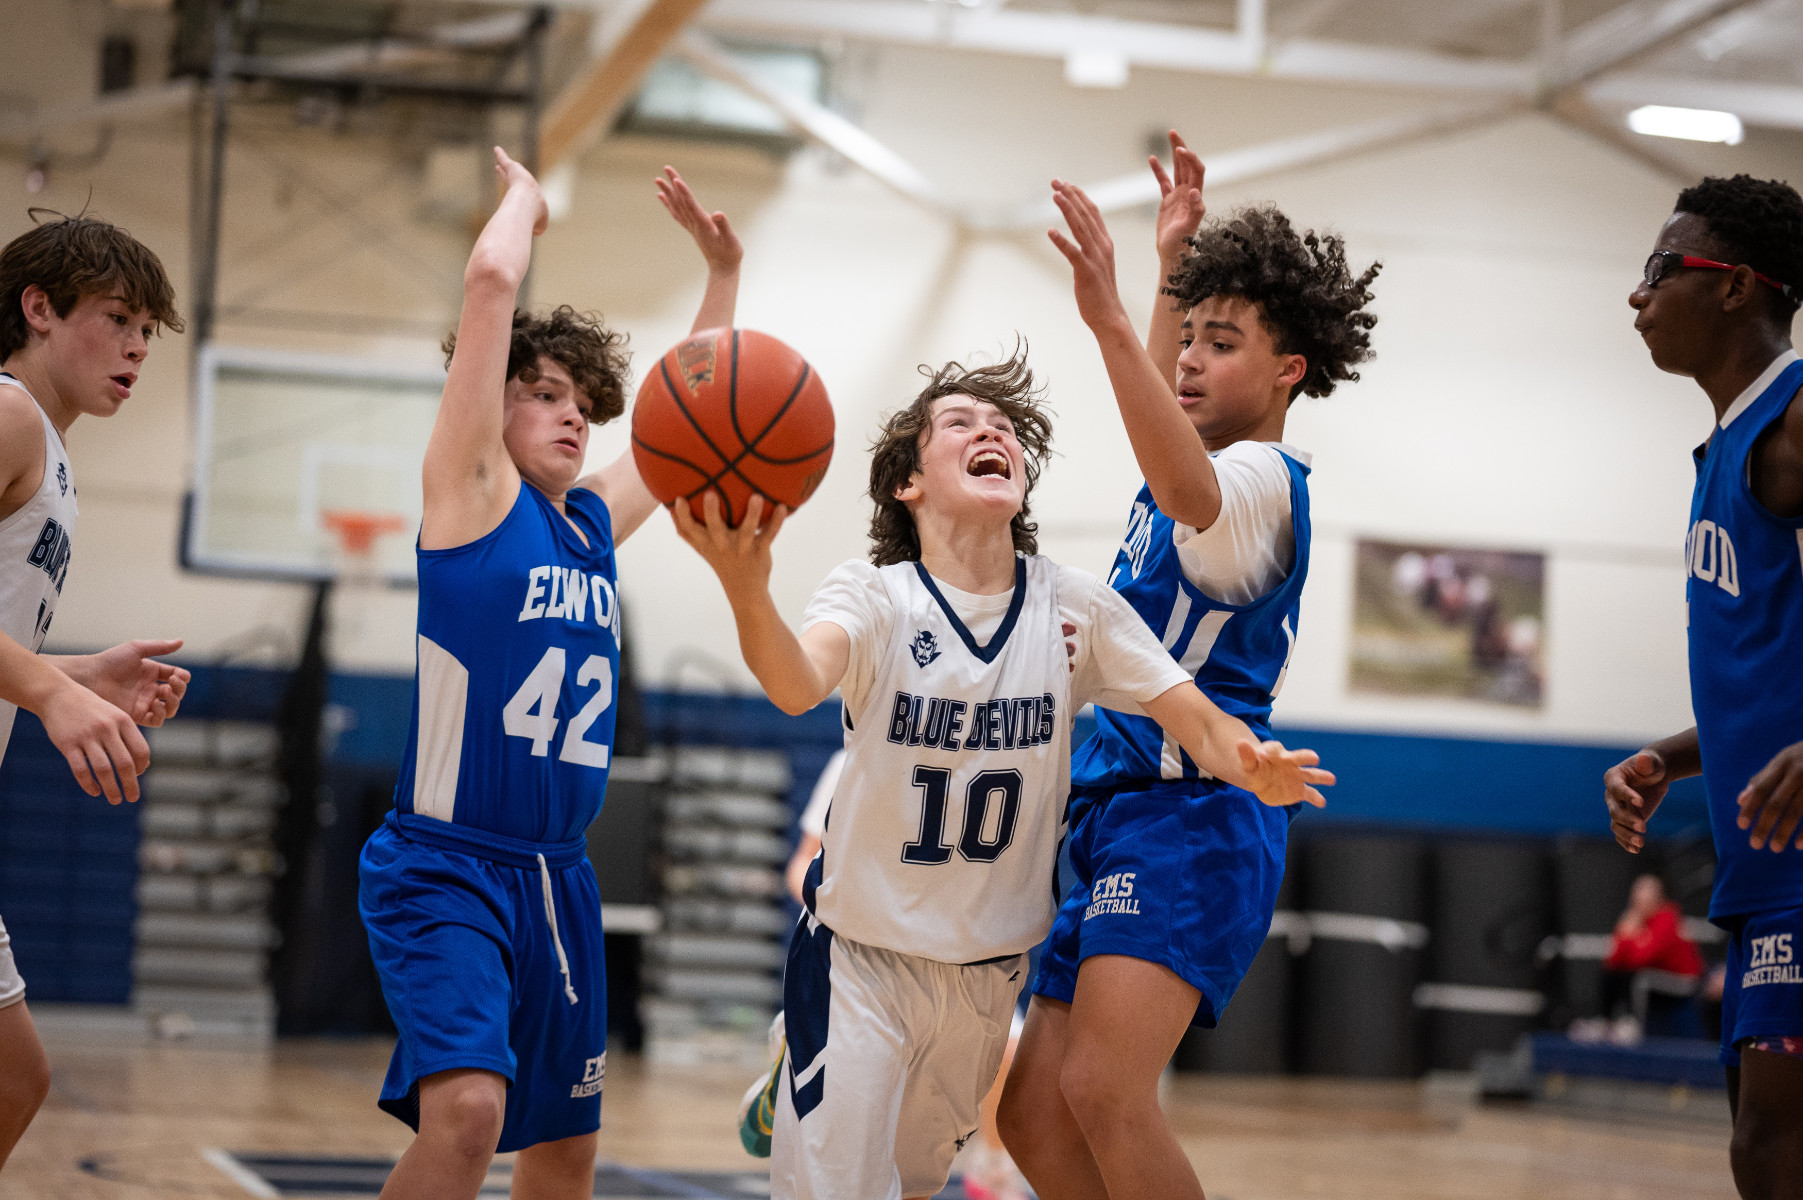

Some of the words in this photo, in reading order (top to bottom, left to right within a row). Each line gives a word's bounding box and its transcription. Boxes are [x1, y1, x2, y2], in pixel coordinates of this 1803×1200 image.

[503, 646, 612, 769] 42
[887, 691, 966, 751] BLUE
[963, 692, 1055, 750] DEVILS
[901, 764, 1023, 865] 10
[1084, 898, 1140, 922] BASKETBALL
[1092, 872, 1136, 903] EMS
[1749, 933, 1793, 968] EMS
